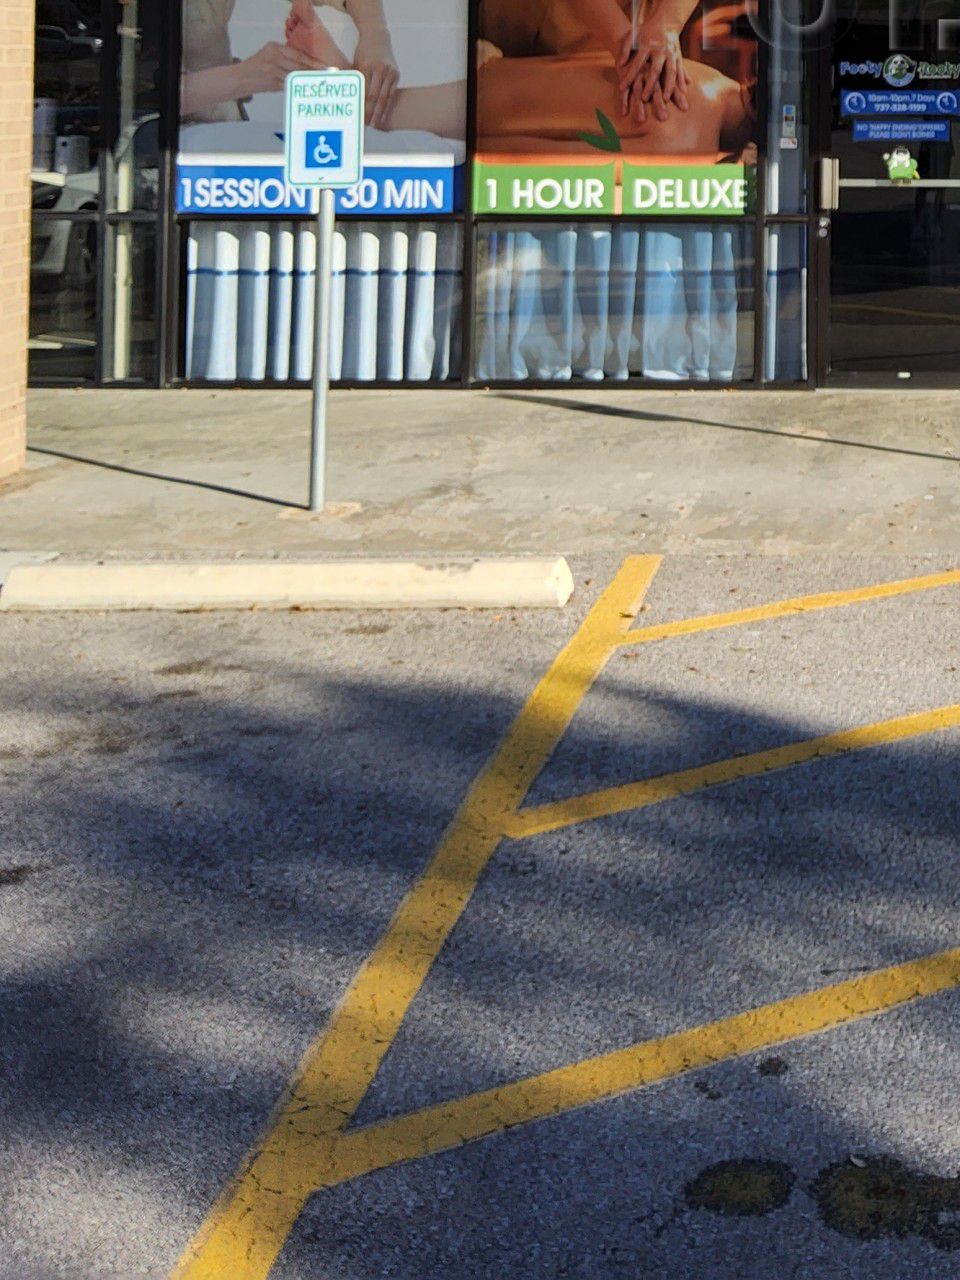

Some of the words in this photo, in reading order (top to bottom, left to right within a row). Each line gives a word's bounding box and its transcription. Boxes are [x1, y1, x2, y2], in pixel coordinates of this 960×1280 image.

[294, 83, 358, 98] RESERVED
[297, 103, 353, 117] PARKING
[340, 178, 378, 208] 30
[384, 178, 444, 209] MIN
[486, 178, 497, 209] 1
[513, 178, 605, 209] HOUR
[633, 178, 748, 209] DELUXE
